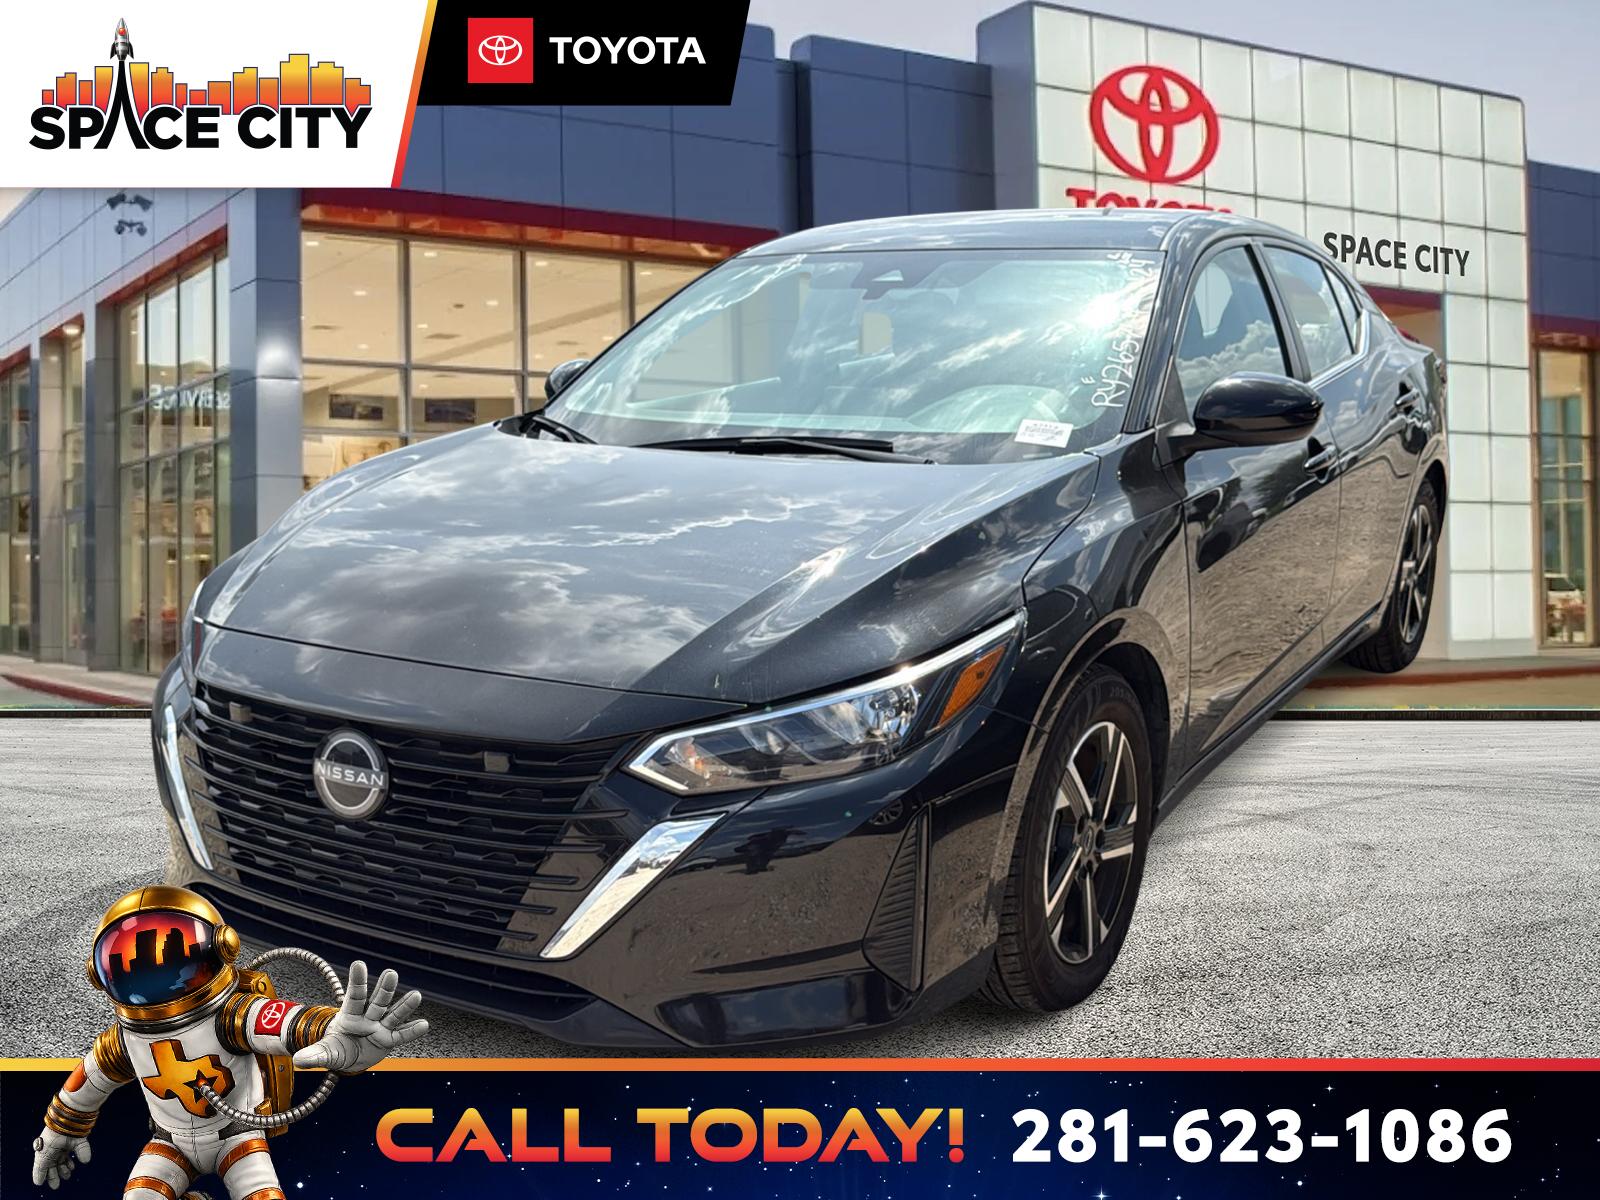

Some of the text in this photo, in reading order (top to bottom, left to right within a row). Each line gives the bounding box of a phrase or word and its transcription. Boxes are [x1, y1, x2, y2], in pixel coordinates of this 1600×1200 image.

[1323, 231, 1470, 276] SPACE CITY
[319, 763, 384, 786] NISSAN
